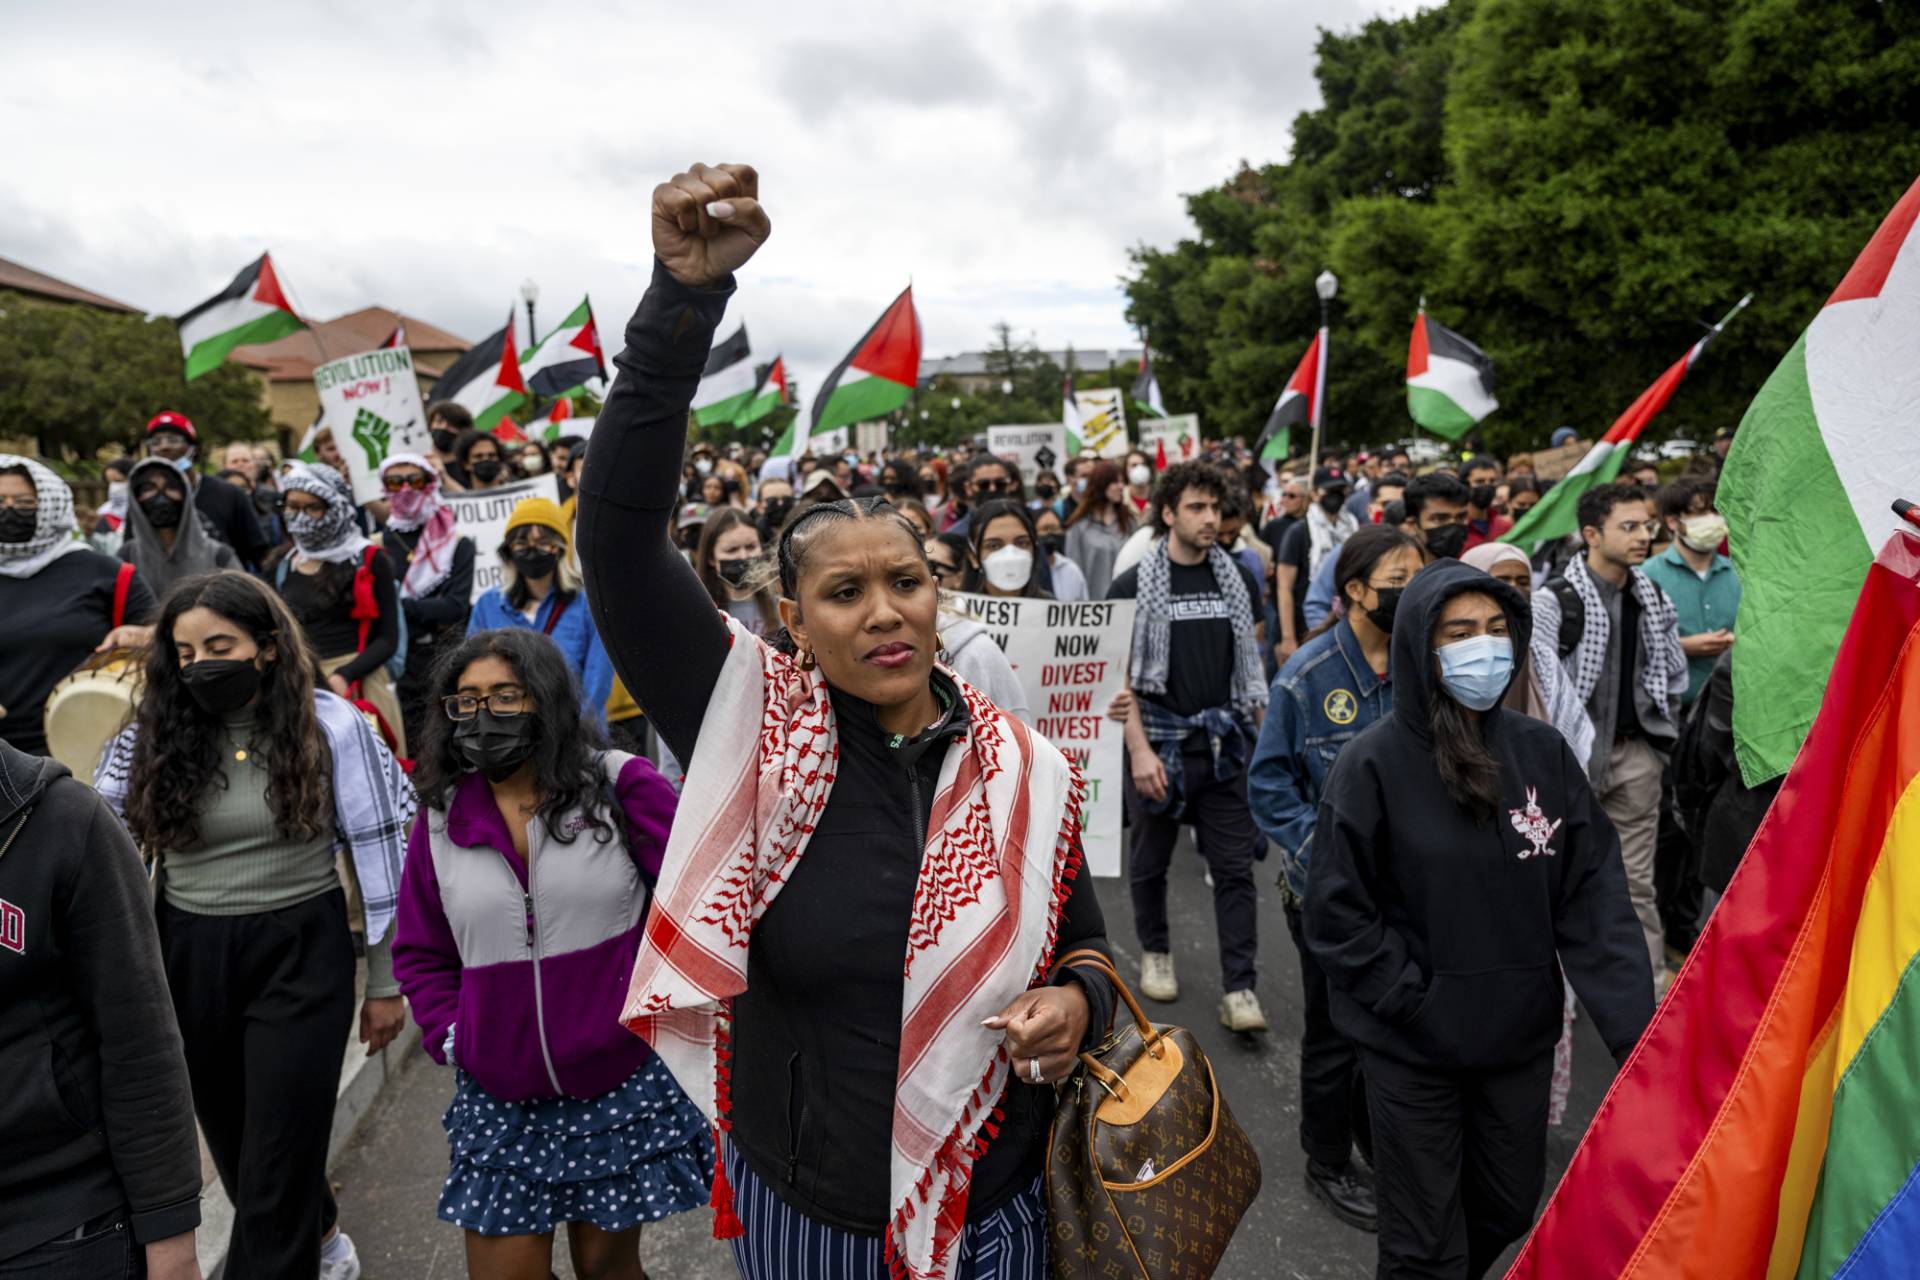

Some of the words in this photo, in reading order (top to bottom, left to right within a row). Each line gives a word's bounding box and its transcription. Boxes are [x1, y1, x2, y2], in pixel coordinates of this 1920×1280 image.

[966, 599, 1021, 626] IVEST
[1047, 603, 1115, 627] DIVEST
[1054, 634, 1101, 658] NOW
[1041, 661, 1107, 687] DIVEST
[1048, 690, 1093, 713] NOW
[1036, 715, 1103, 740] DIVEST
